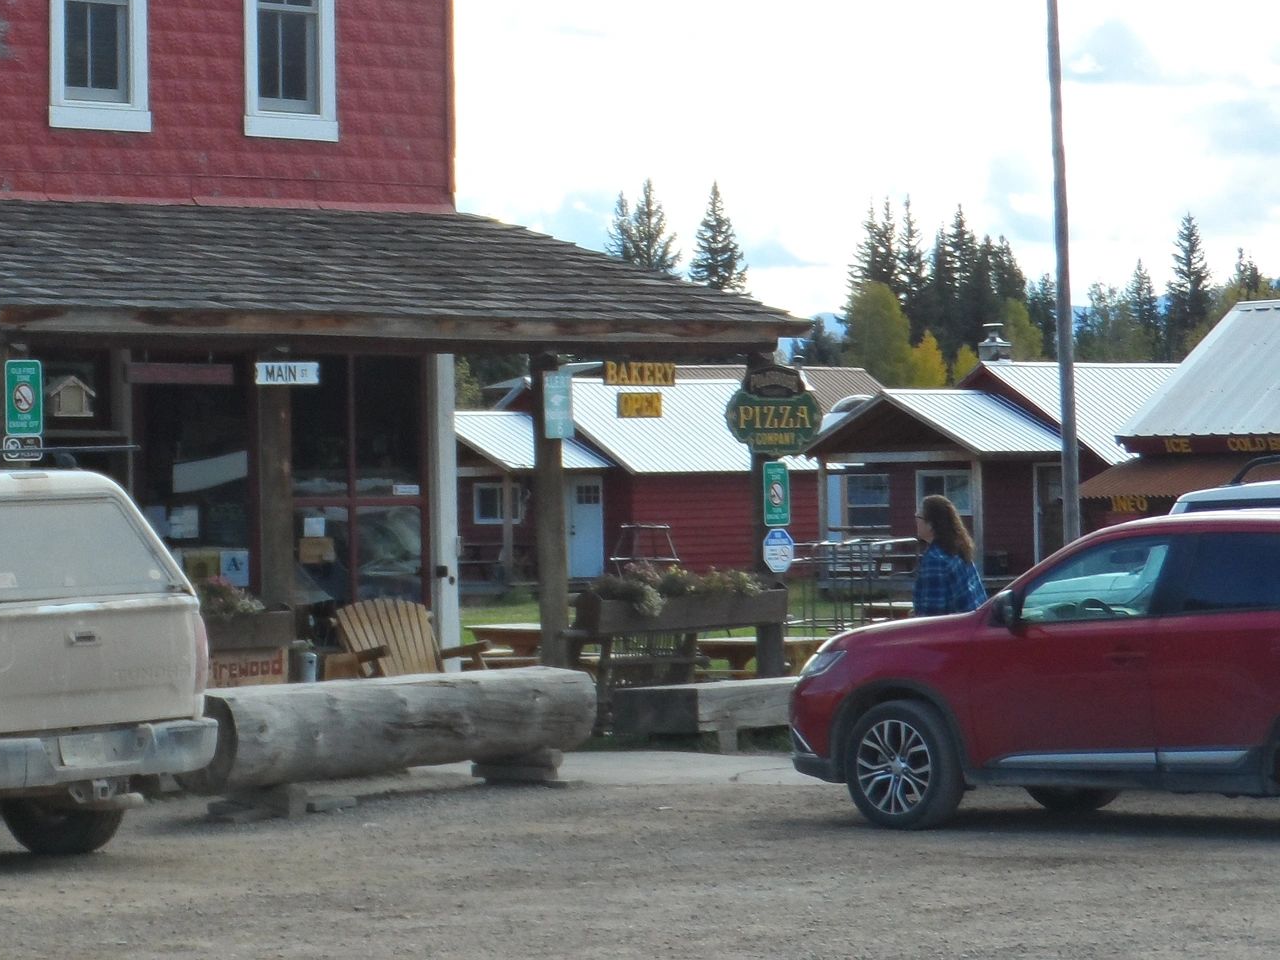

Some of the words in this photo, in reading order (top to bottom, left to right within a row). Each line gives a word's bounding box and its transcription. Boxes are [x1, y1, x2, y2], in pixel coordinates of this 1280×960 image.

[265, 365, 297, 382] MAIN
[606, 361, 675, 385] BAKERY
[621, 393, 662, 416] OPEN
[738, 405, 812, 429] PIZZA
[1164, 439, 1192, 453] ICE
[1227, 437, 1266, 452] COLD
[1111, 496, 1148, 512] INFO
